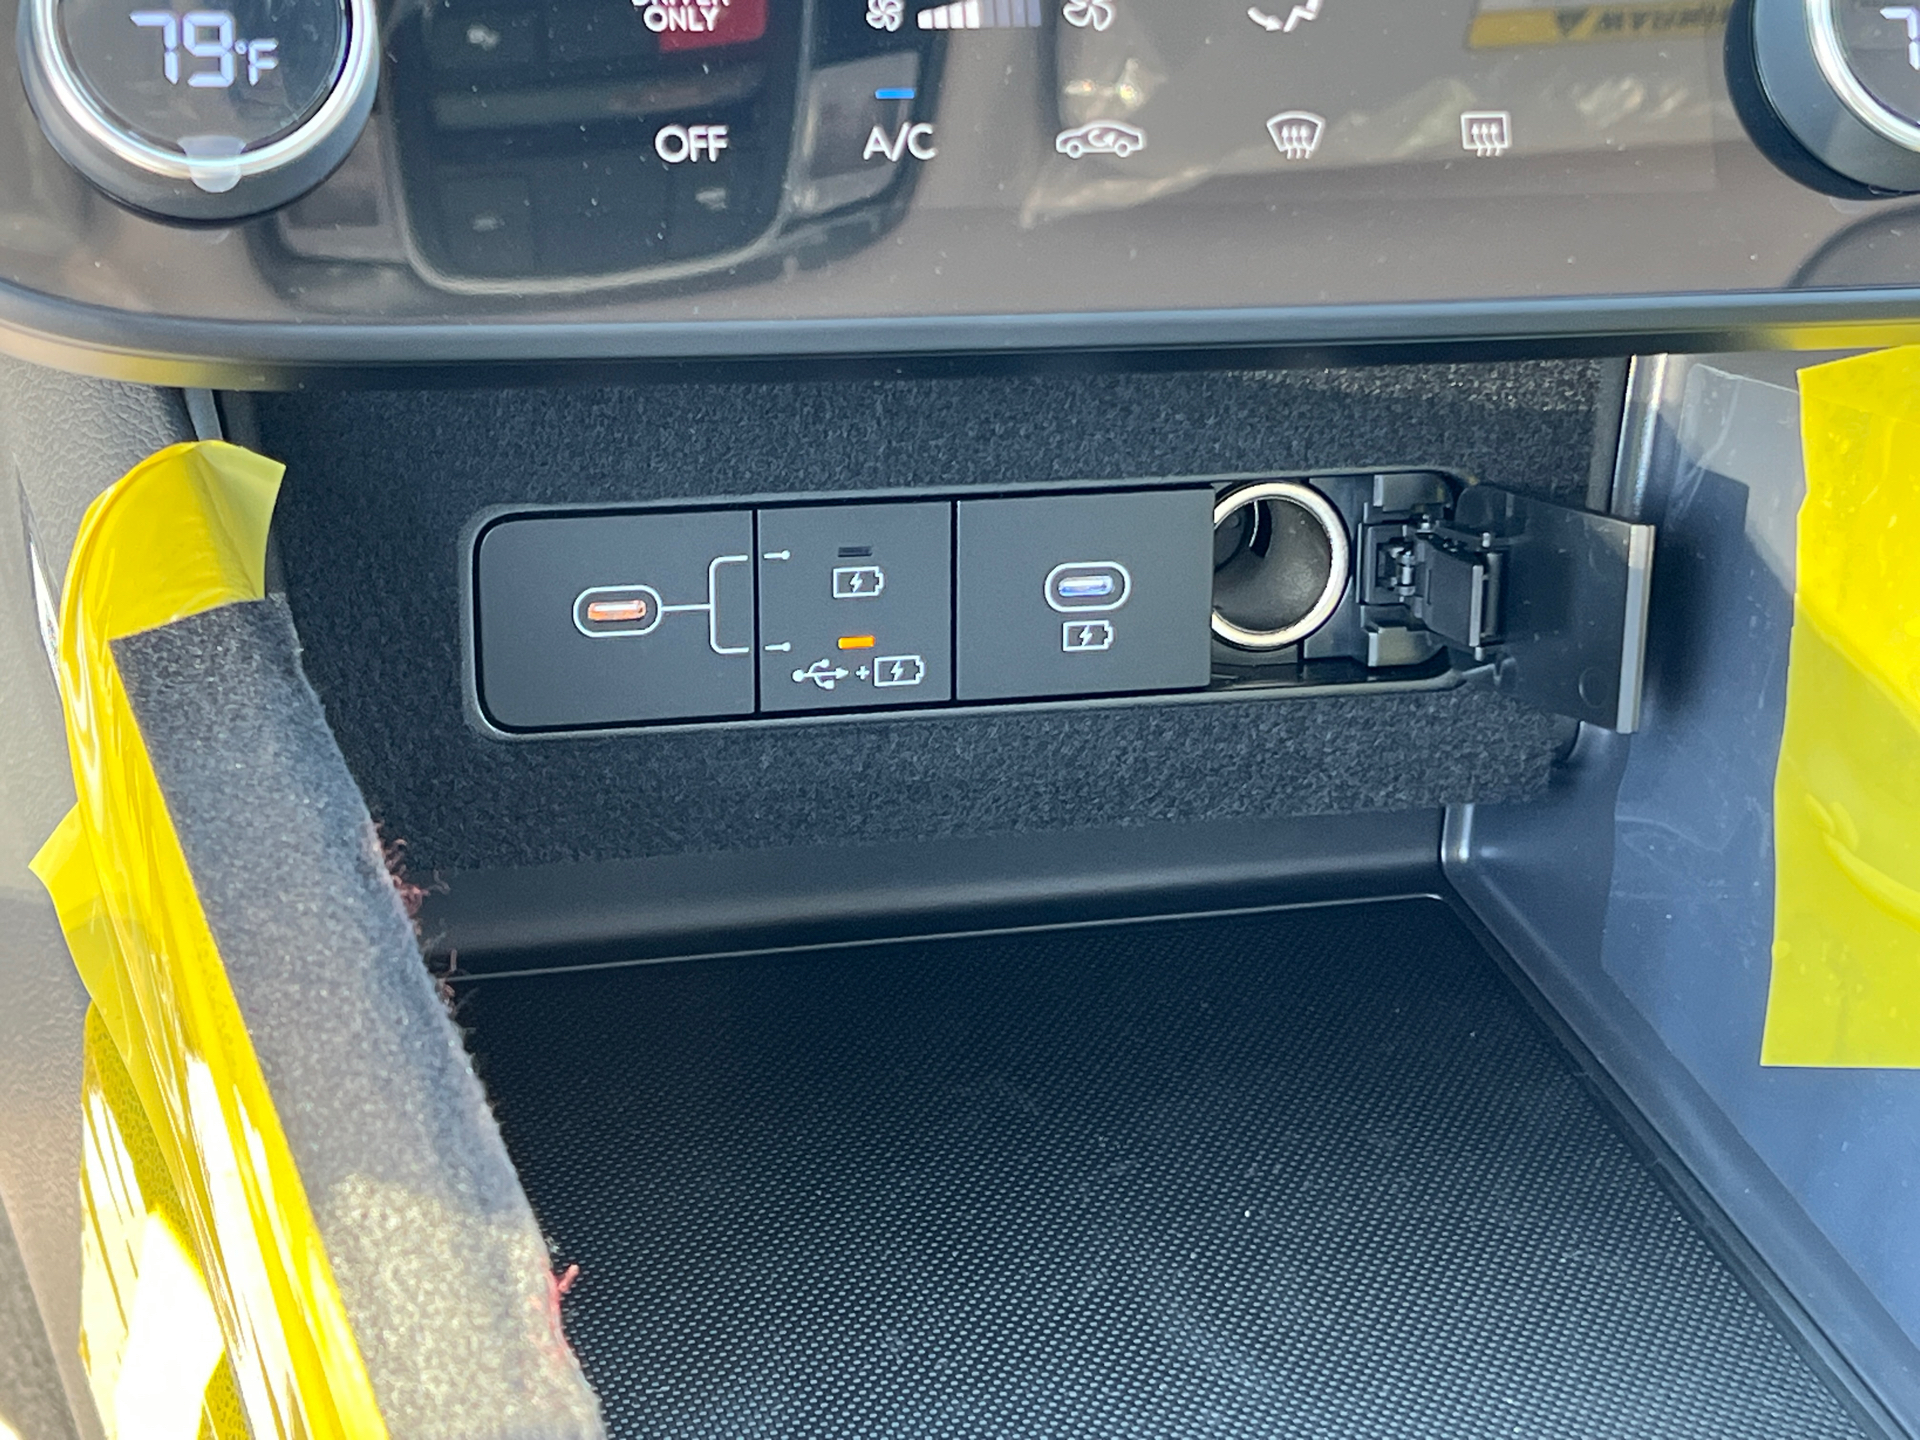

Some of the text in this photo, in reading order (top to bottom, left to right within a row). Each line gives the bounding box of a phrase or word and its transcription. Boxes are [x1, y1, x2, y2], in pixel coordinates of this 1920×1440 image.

[643, 4, 720, 33] ONLY
[654, 124, 729, 163] OFF
[862, 121, 938, 162] A/C
